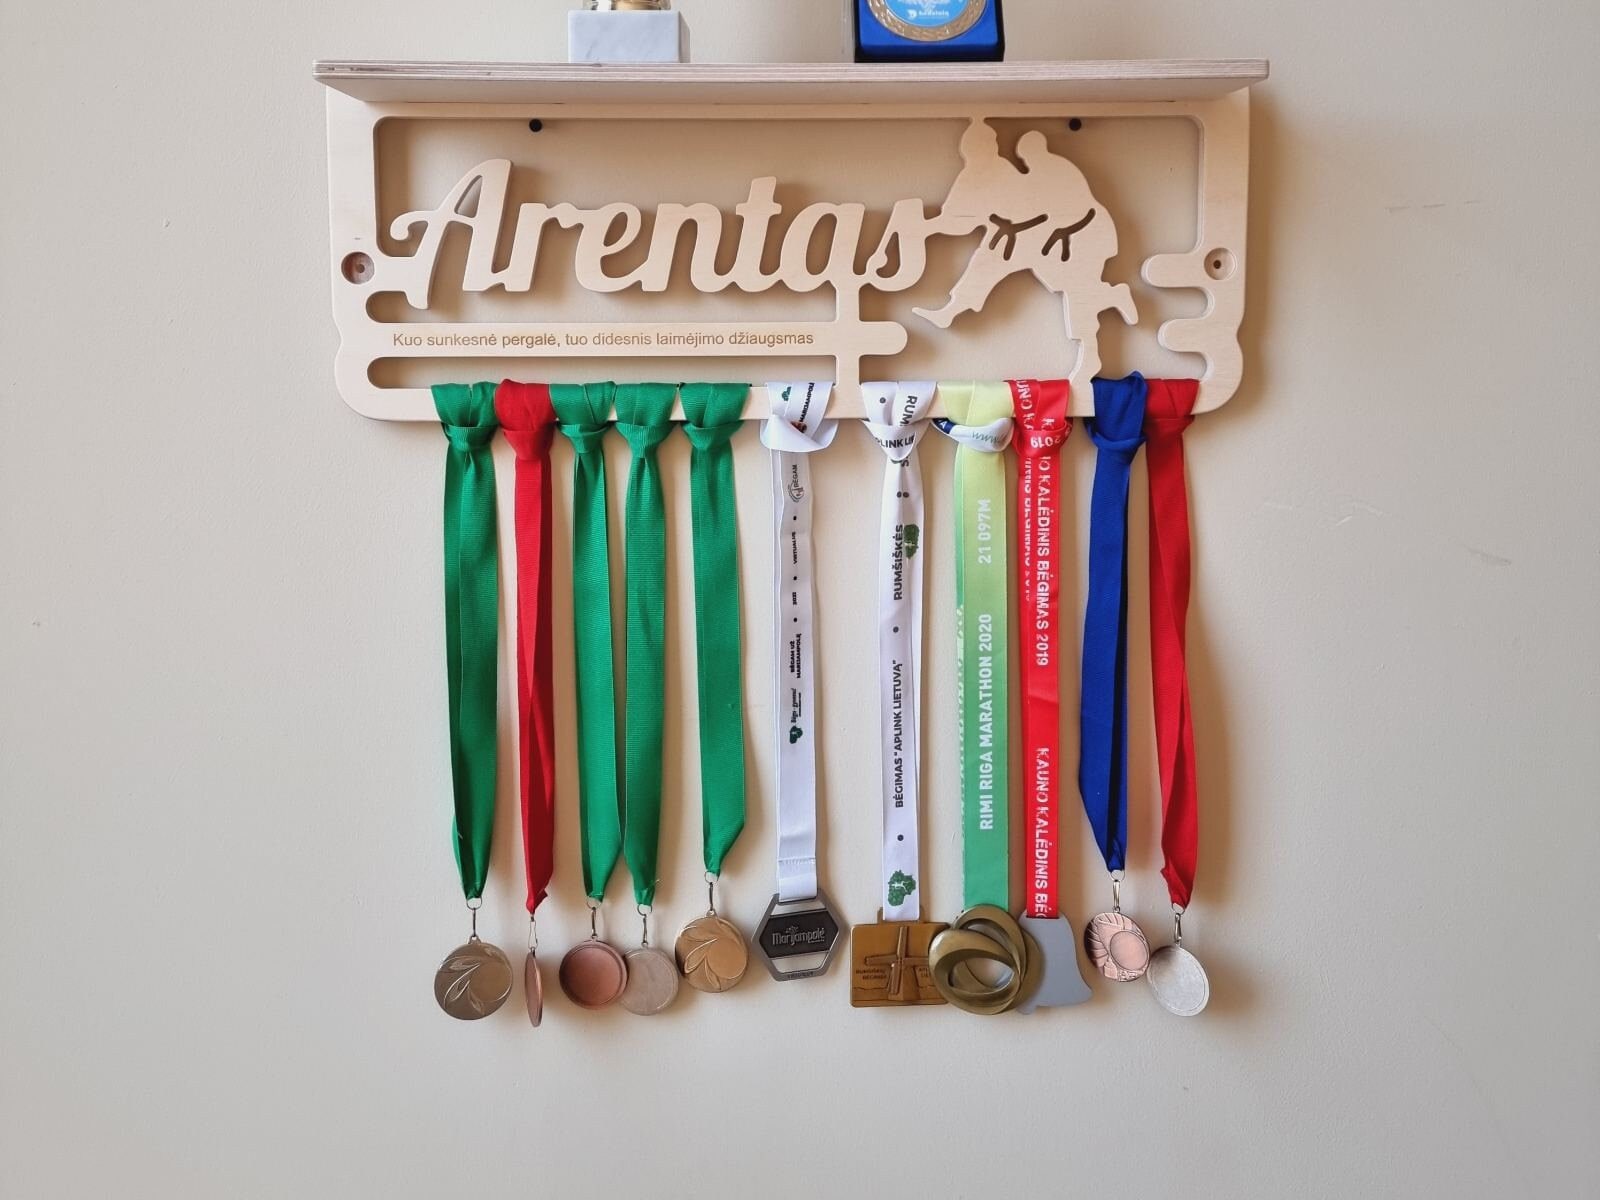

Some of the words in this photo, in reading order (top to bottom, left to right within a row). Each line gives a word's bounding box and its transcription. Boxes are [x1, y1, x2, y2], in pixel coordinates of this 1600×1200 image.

[390, 158, 930, 310] Arentas
[393, 333, 423, 346] Kuo
[426, 333, 498, 346] sunkesnė
[501, 332, 561, 349] pergalė,
[565, 333, 589, 346] tuo
[592, 332, 653, 346] didesnis
[656, 331, 725, 348] laimėjimo
[728, 331, 814, 348] džiaugsmas
[1030, 434, 1061, 449] 2019
[977, 498, 992, 541] 097M
[1037, 475, 1053, 556] KALĖDINIS
[892, 524, 903, 601] RUMŠIŠKĖS
[978, 546, 992, 564] 21
[1036, 560, 1053, 629] BĖGIMAS
[978, 613, 992, 652] 2020
[1035, 633, 1049, 666] 2019
[978, 656, 993, 748] MARATHON
[892, 757, 904, 808] BĖGIMAS
[979, 751, 993, 790] RIGA
[1035, 747, 1050, 803] KAUNO
[979, 795, 993, 830] RIMI
[1035, 806, 1052, 889] KALĖDINIS
